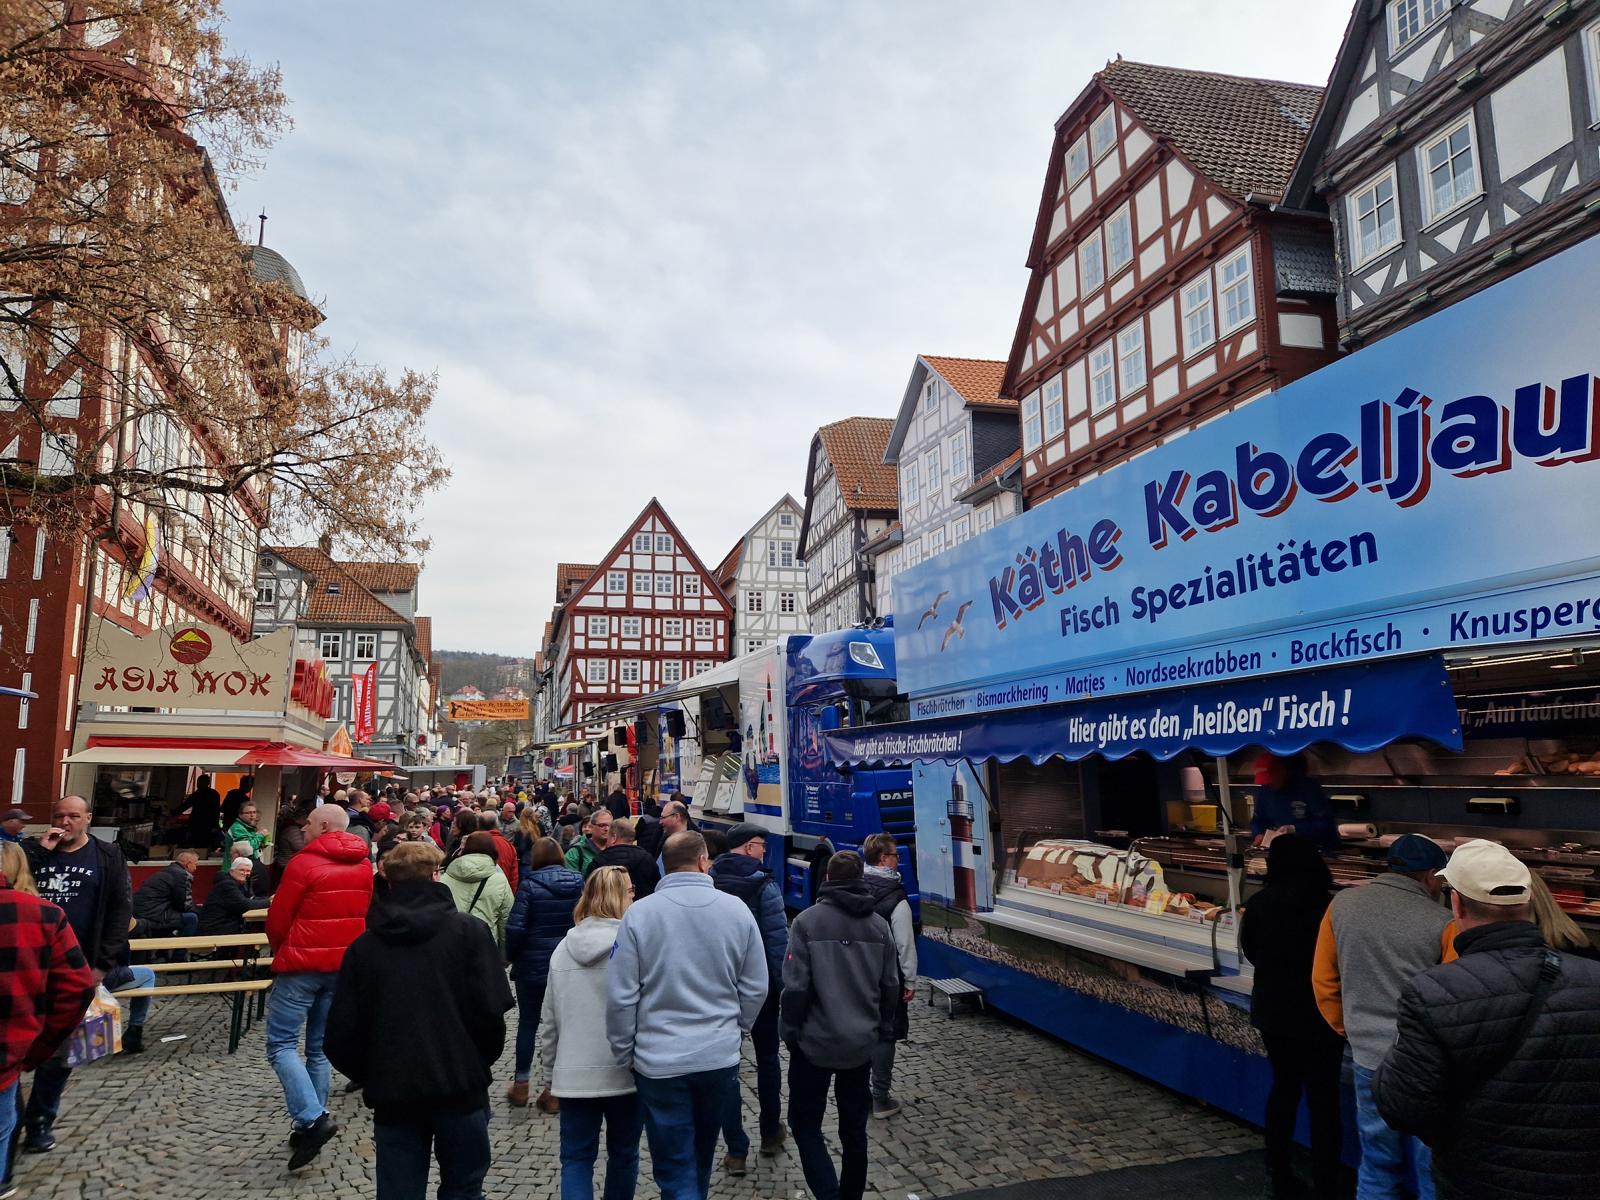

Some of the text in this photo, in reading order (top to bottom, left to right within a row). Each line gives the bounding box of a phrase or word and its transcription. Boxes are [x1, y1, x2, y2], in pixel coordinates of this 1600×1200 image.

[988, 373, 1600, 629] Käthe Kabeljau
[1060, 531, 1379, 637] Fisch Spezialitäten
[94, 666, 180, 693] ASIA
[191, 671, 272, 696] WOK
[916, 696, 966, 717] Fischbrötchen
[976, 682, 1049, 708] Bismarckhering
[1065, 674, 1105, 697] Matjes
[1126, 650, 1262, 687] Nordseekrabben
[1290, 622, 1402, 665] Backfisch
[1069, 717, 1096, 743] Hier
[1098, 713, 1127, 748] gibt
[1130, 717, 1146, 738] es
[1150, 709, 1180, 737] den
[854, 739, 865, 756] Hier
[866, 738, 878, 759] gibt
[885, 736, 906, 755] frische
[880, 791, 912, 801] DAF
[64, 865, 94, 876] YORK
[71, 880, 82, 888] 79
